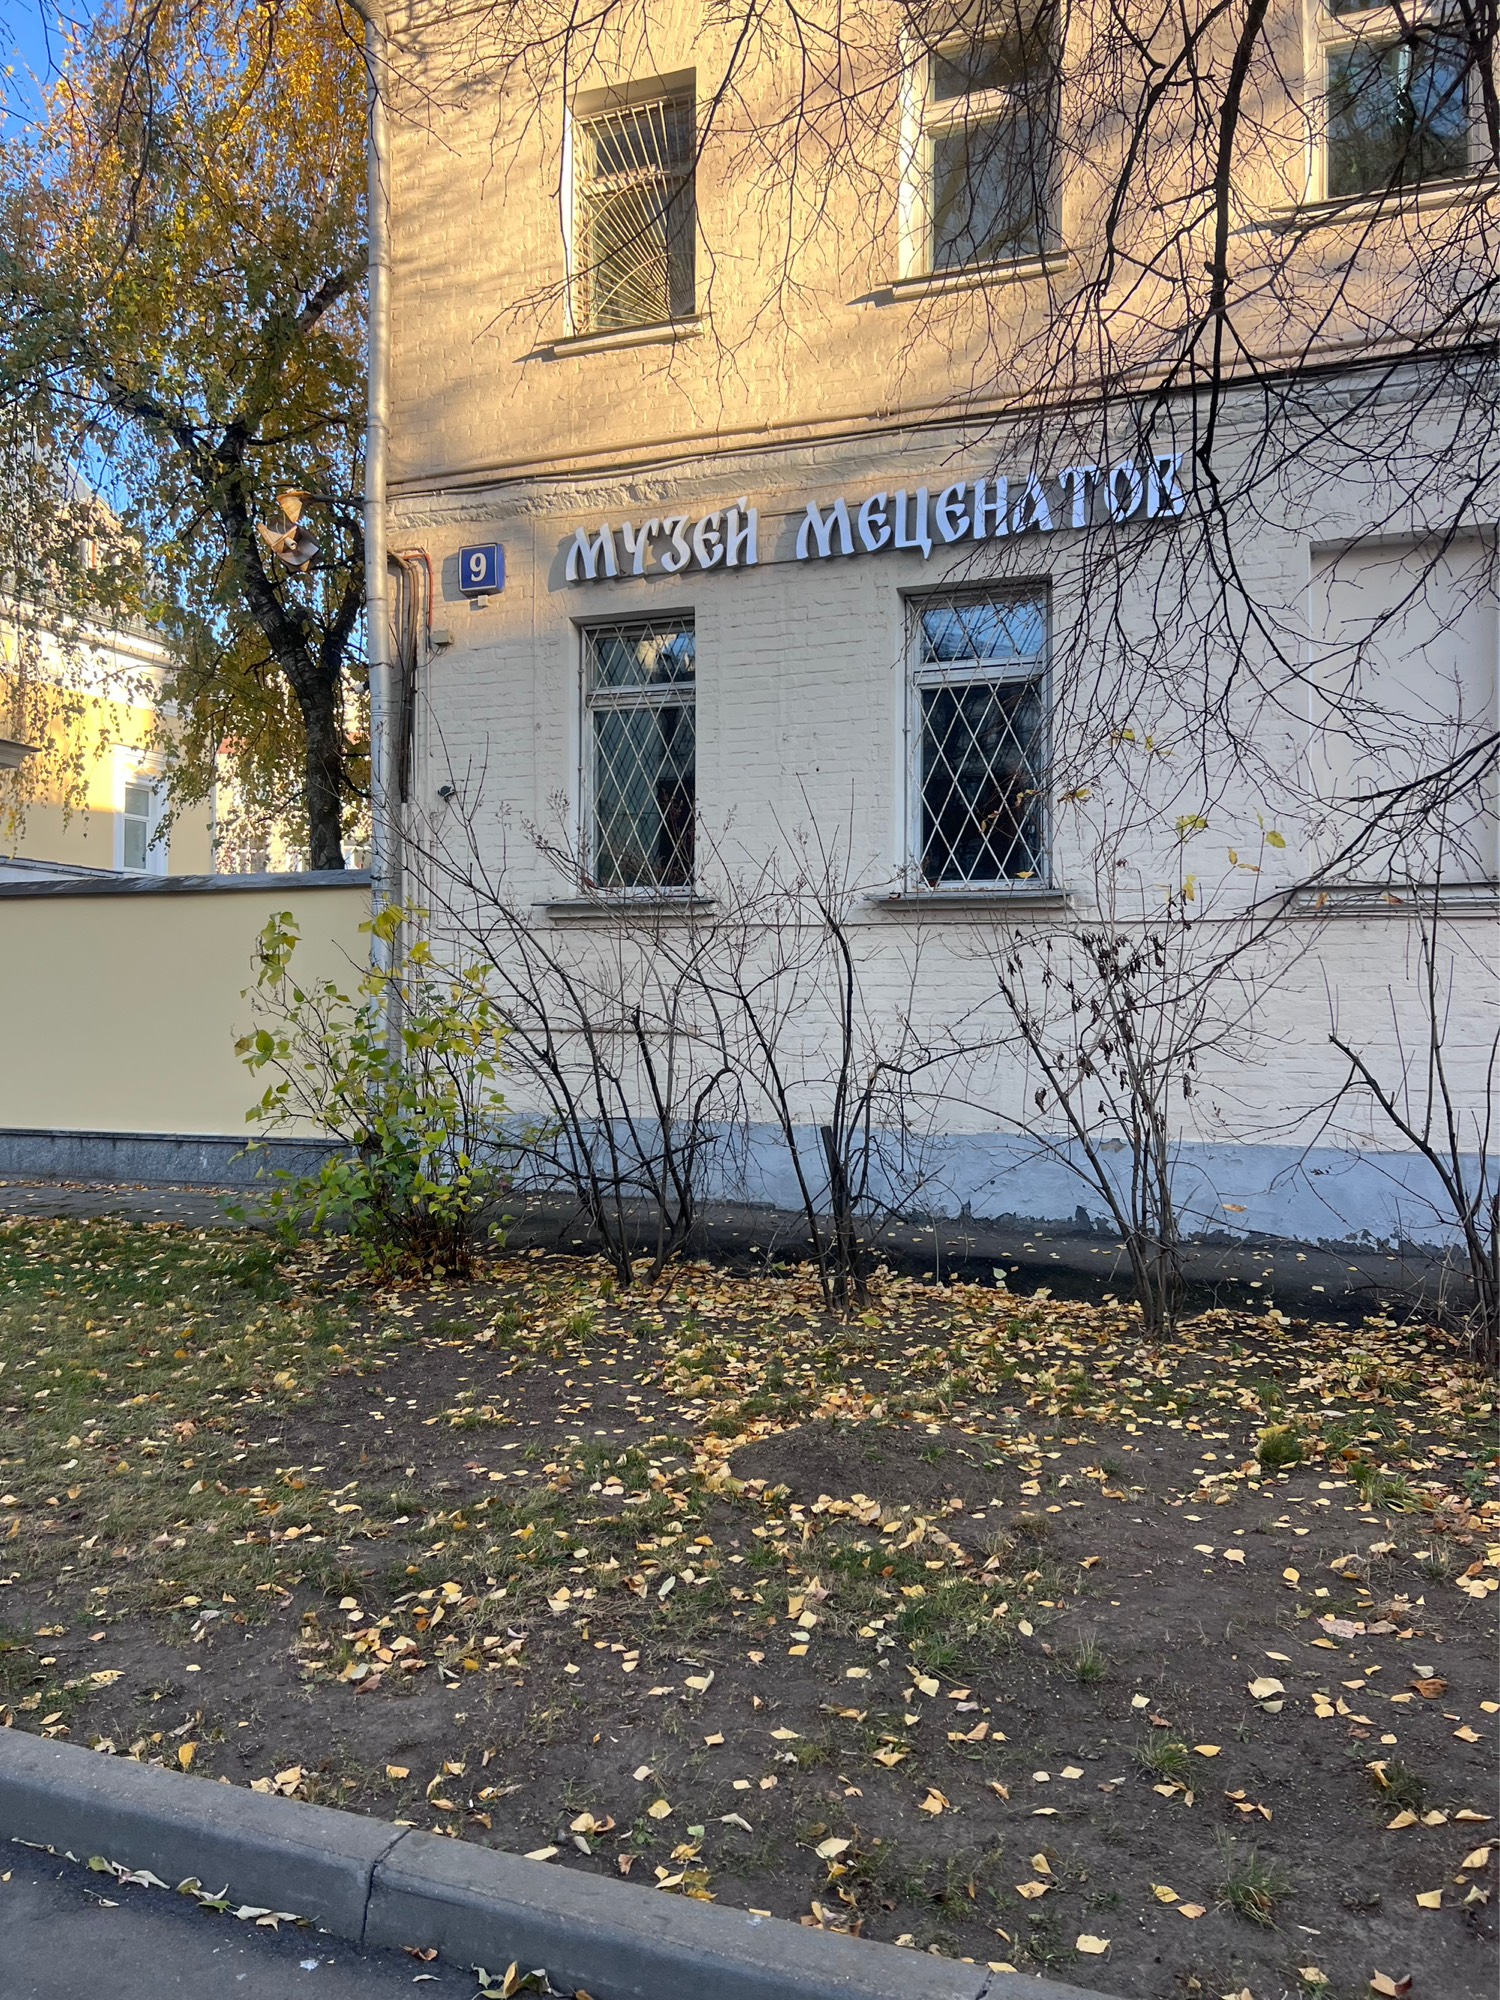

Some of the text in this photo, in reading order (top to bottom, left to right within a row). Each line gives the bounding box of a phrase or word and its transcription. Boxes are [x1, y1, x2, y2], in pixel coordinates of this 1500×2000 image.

[565, 452, 1186, 582] МУЗЕЙ МЕЦЕНАТОВ
[469, 552, 487, 582] 9
